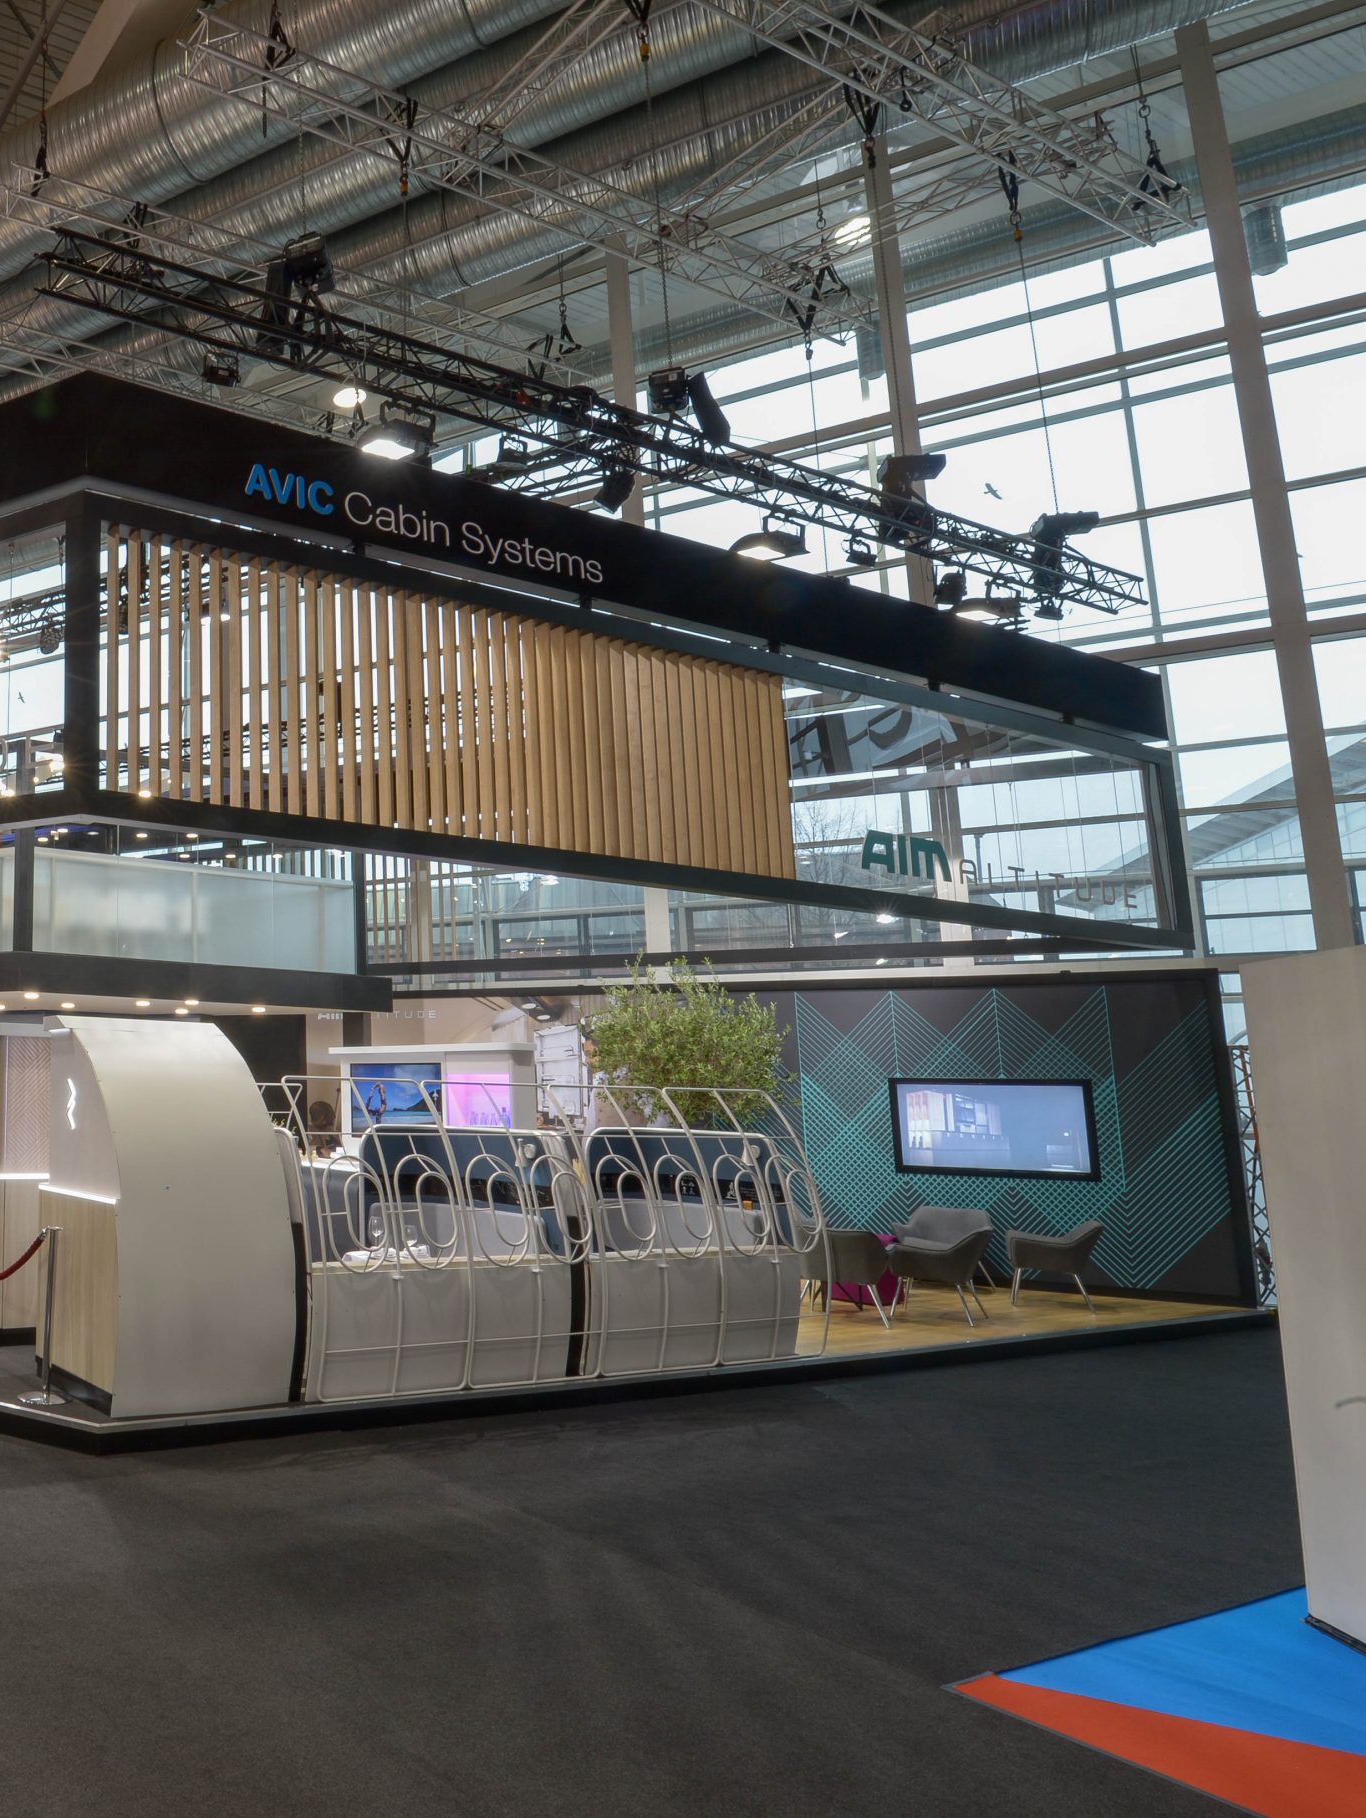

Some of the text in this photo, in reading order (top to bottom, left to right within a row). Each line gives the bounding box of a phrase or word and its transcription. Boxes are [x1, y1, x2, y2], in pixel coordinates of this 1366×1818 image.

[245, 463, 604, 583] AVIC Cabin Systems
[862, 829, 1138, 909] AIM ALTITUDE
